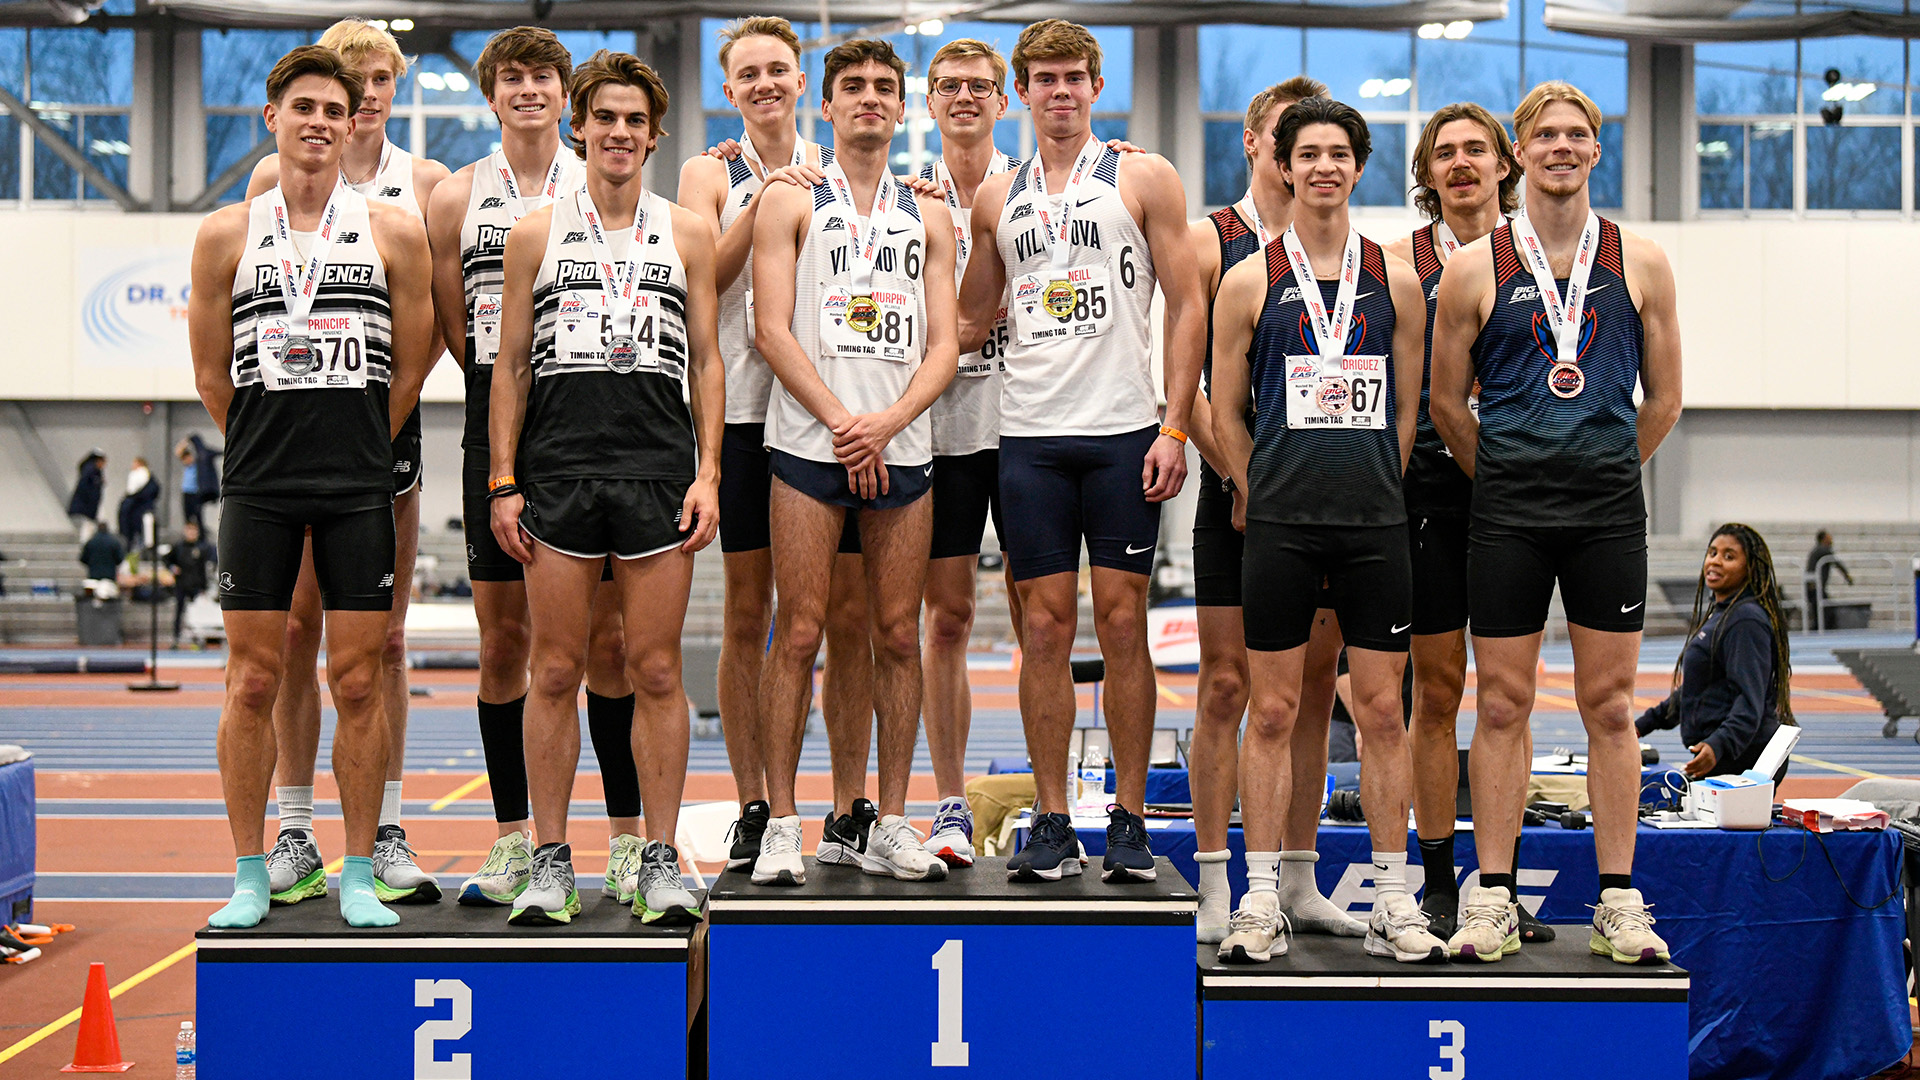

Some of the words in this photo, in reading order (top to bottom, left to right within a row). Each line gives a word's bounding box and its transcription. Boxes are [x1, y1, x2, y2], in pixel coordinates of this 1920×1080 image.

[503, 169, 511, 180] BIG
[551, 163, 560, 183] EAST
[1072, 173, 1080, 184] BIG
[1077, 155, 1088, 174] EAST
[506, 180, 517, 199] EAST
[279, 218, 287, 240] EAST
[321, 223, 330, 238] BIG
[326, 204, 336, 225] EAST
[588, 212, 597, 224] BIG
[592, 224, 604, 244] EAST
[1015, 219, 1101, 263] VILOVA
[1295, 251, 1304, 262] BIG
[1528, 237, 1537, 249] BIG
[1533, 249, 1546, 270] EAST
[1579, 250, 1587, 264] BIG
[1583, 229, 1591, 251] EAST
[905, 239, 921, 280] 6
[1120, 246, 1135, 289] 6
[253, 264, 374, 297] PRENCE
[303, 281, 311, 295] BIG
[308, 257, 318, 281] EAST
[622, 284, 630, 298] BIG
[626, 261, 635, 283] EAST
[1068, 269, 1091, 282] NEILL
[1299, 261, 1311, 282] EAST
[127, 284, 173, 304] DR.
[287, 274, 297, 297] EAST
[1017, 288, 1040, 297] EAST
[1019, 282, 1035, 290] BIG
[1514, 285, 1536, 293] BIG
[1570, 283, 1578, 307] EAST
[872, 292, 907, 305] MURPHY
[1057, 286, 1107, 323] 85
[1314, 302, 1323, 316] BIG
[1319, 316, 1328, 339] EAST
[1337, 301, 1345, 324] EAST
[308, 318, 350, 330] PRINCIPE
[1032, 330, 1052, 340] TIMING
[1054, 328, 1067, 337] TAG
[837, 345, 861, 353] TIMING
[863, 346, 876, 354] TAG
[981, 326, 1009, 360] 65
[956, 365, 978, 373] IMING
[1340, 359, 1378, 371] DRIGUEZ
[277, 377, 302, 386] TIMING
[1346, 378, 1382, 412] 67
[1305, 416, 1328, 424] TIMING
[1330, 416, 1343, 424] TAG
[1326, 863, 1559, 925] BG
[931, 940, 969, 1067] 1
[414, 979, 472, 1080] 2
[1429, 1020, 1466, 1080] 3
